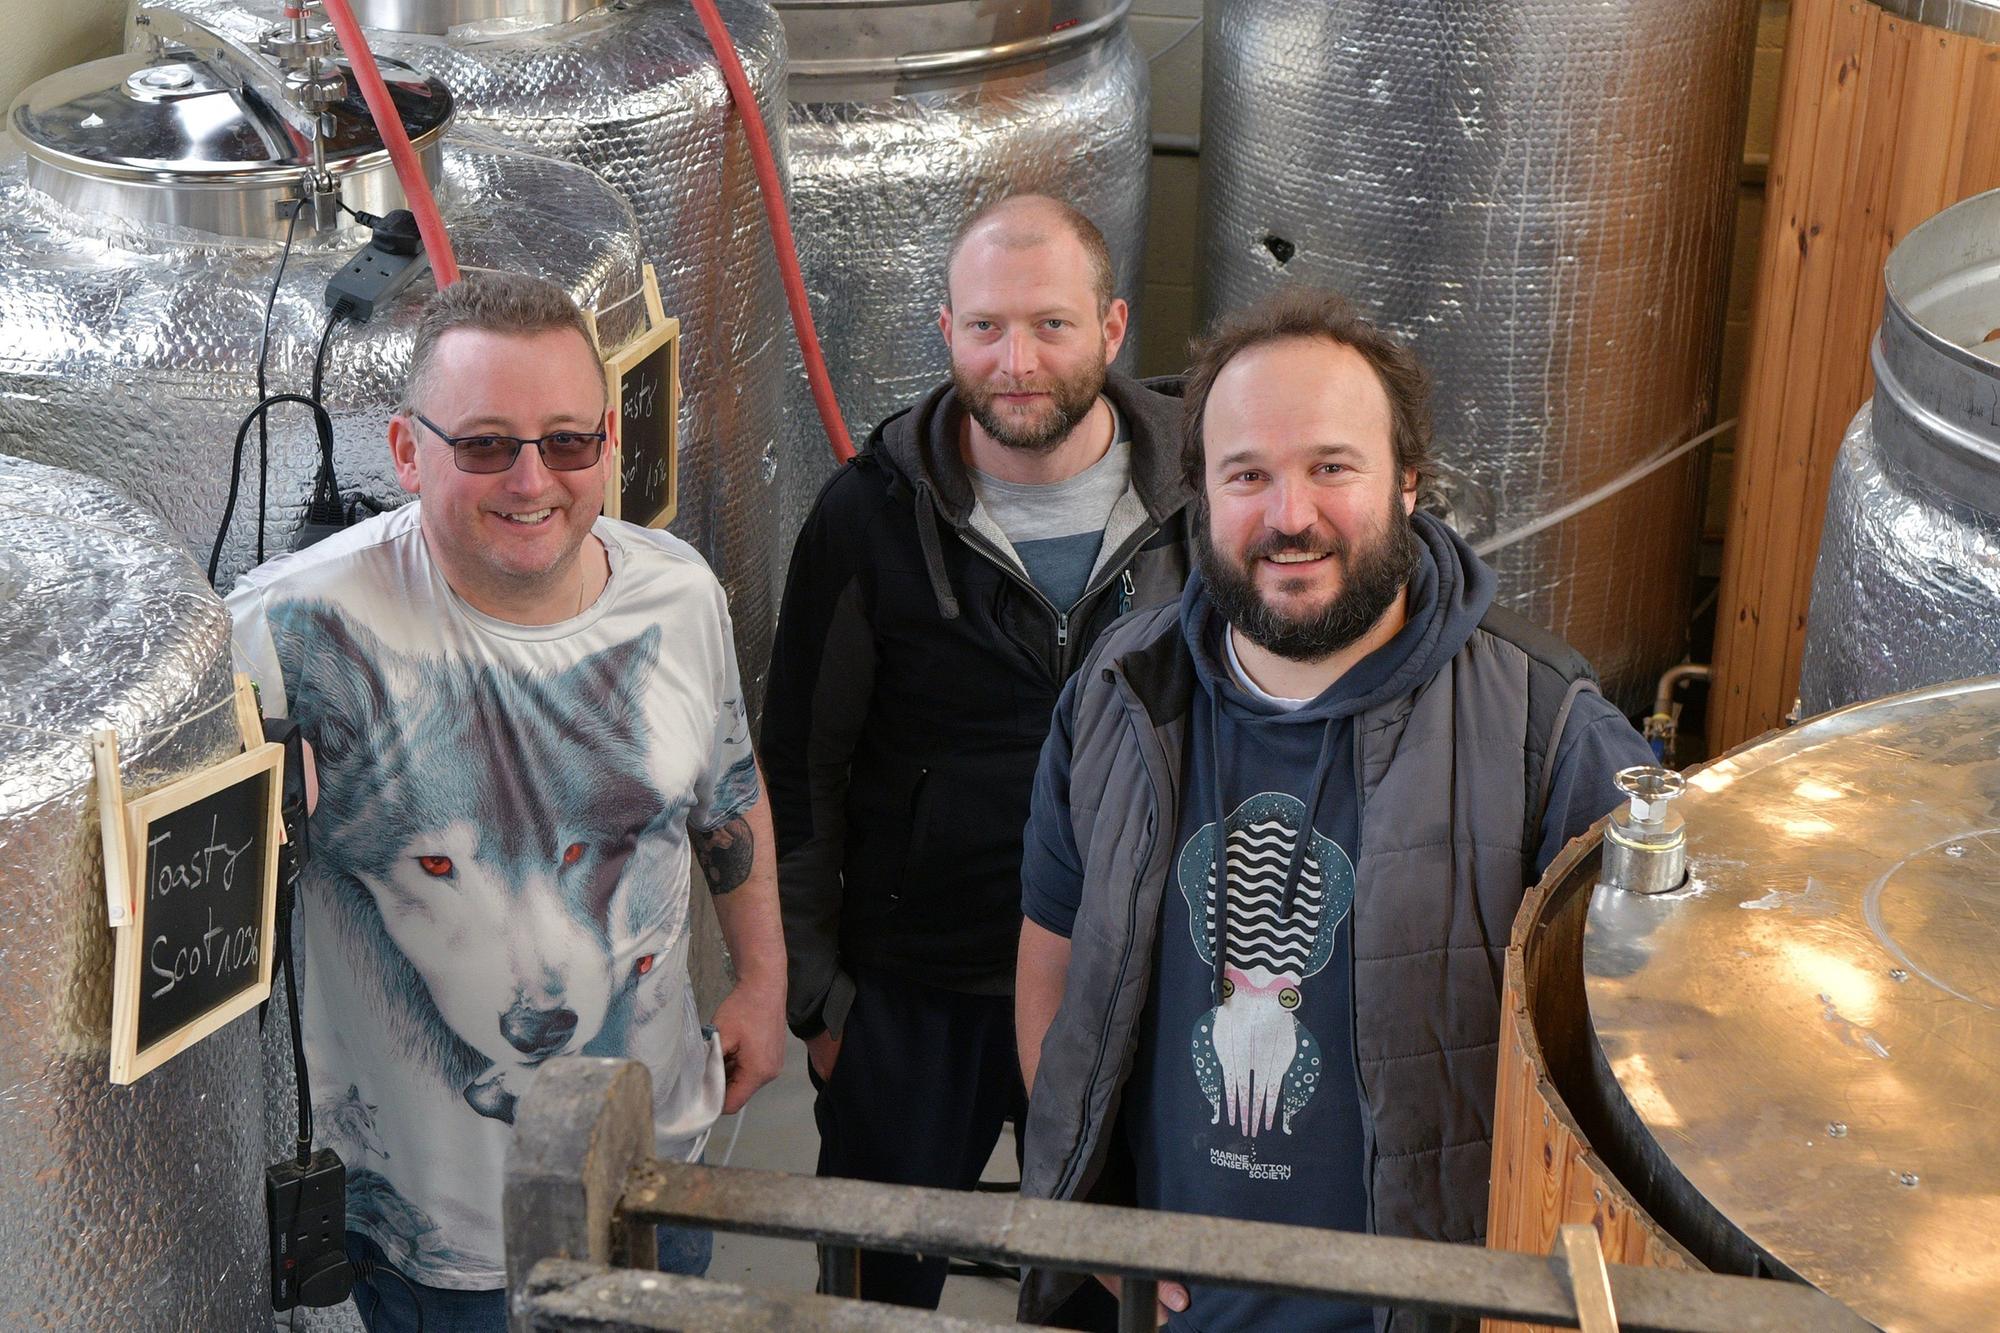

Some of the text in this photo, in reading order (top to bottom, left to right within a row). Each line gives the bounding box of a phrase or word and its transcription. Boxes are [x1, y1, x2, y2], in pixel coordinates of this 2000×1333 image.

[148, 814, 253, 900] Toasty
[151, 906, 225, 1000] Scot
[1210, 1148, 1249, 1163] MARINE
[1210, 1156, 1291, 1173] CONSERVATION
[1249, 1171, 1291, 1180] SOCIETY
